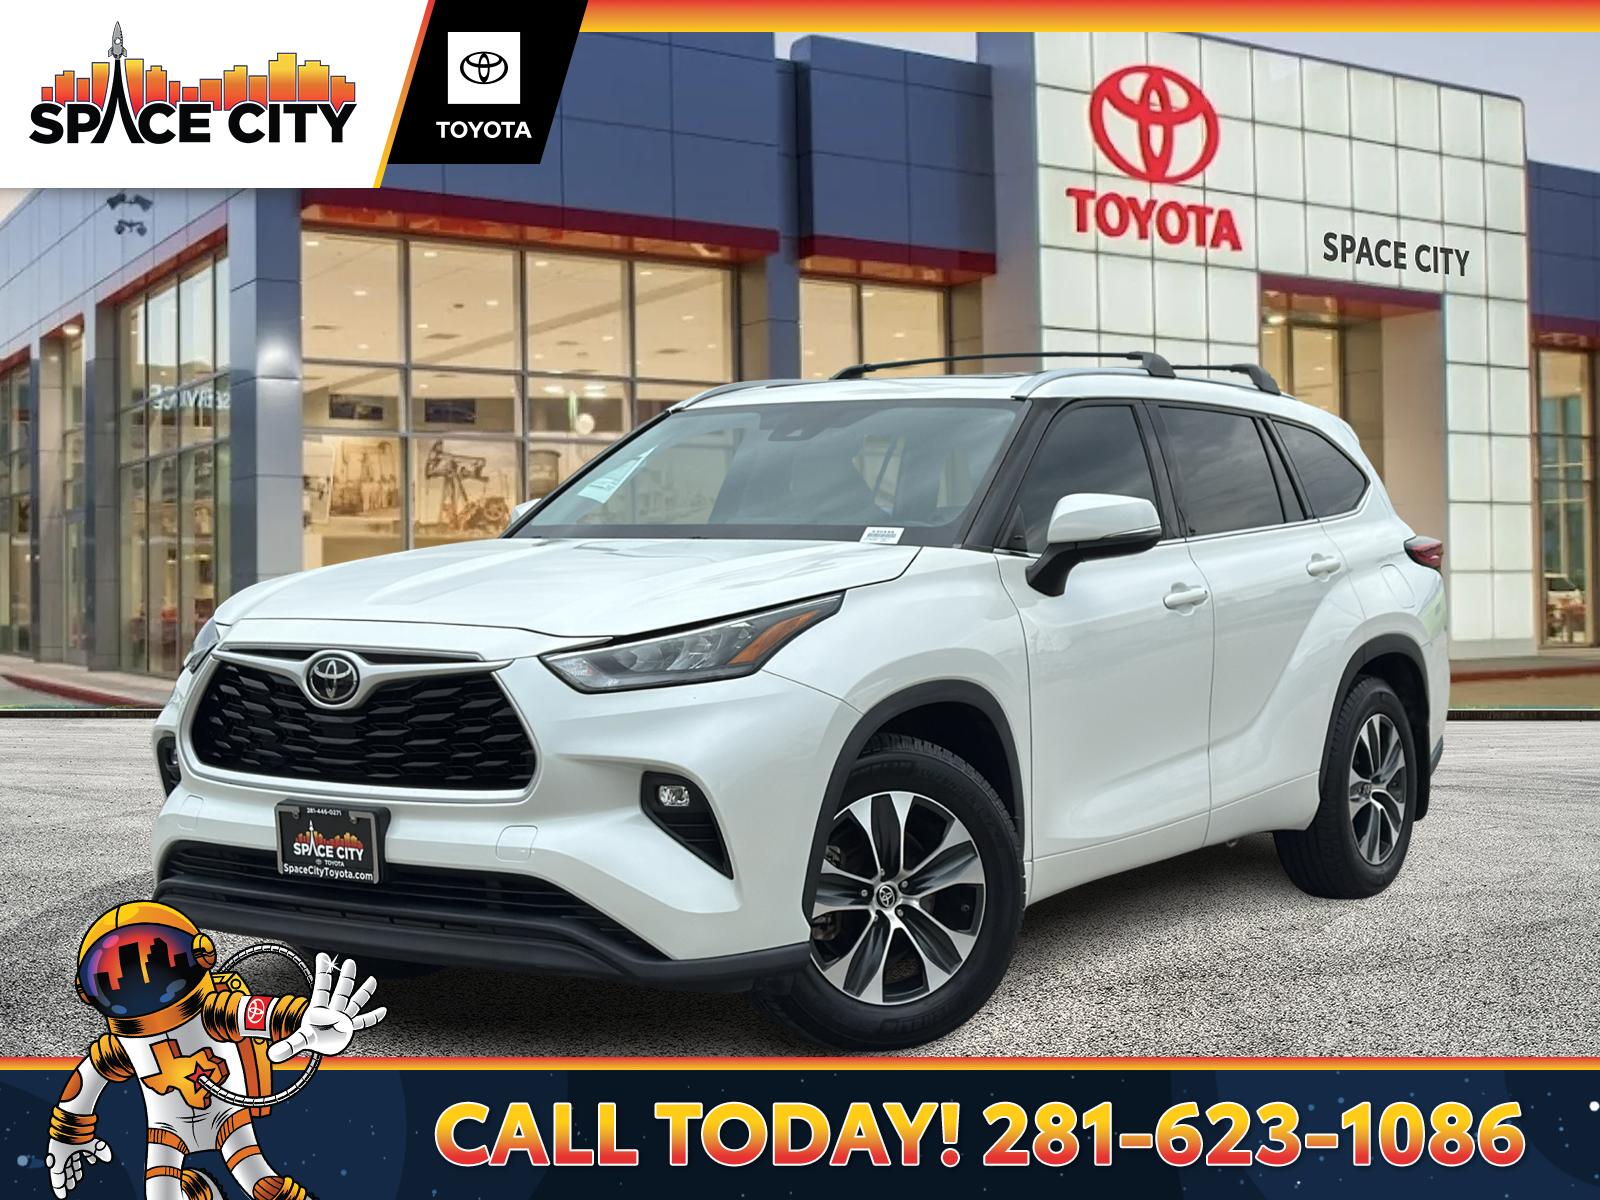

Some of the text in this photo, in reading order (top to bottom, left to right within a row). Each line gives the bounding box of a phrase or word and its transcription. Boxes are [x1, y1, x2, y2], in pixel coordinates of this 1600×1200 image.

[1066, 187, 1242, 251] TOYOTA
[1323, 231, 1470, 276] SPACE CITY
[336, 847, 364, 861] CITY
[283, 863, 373, 880] SpaceCityToyota.com
[324, 859, 345, 867] TOYOTA
